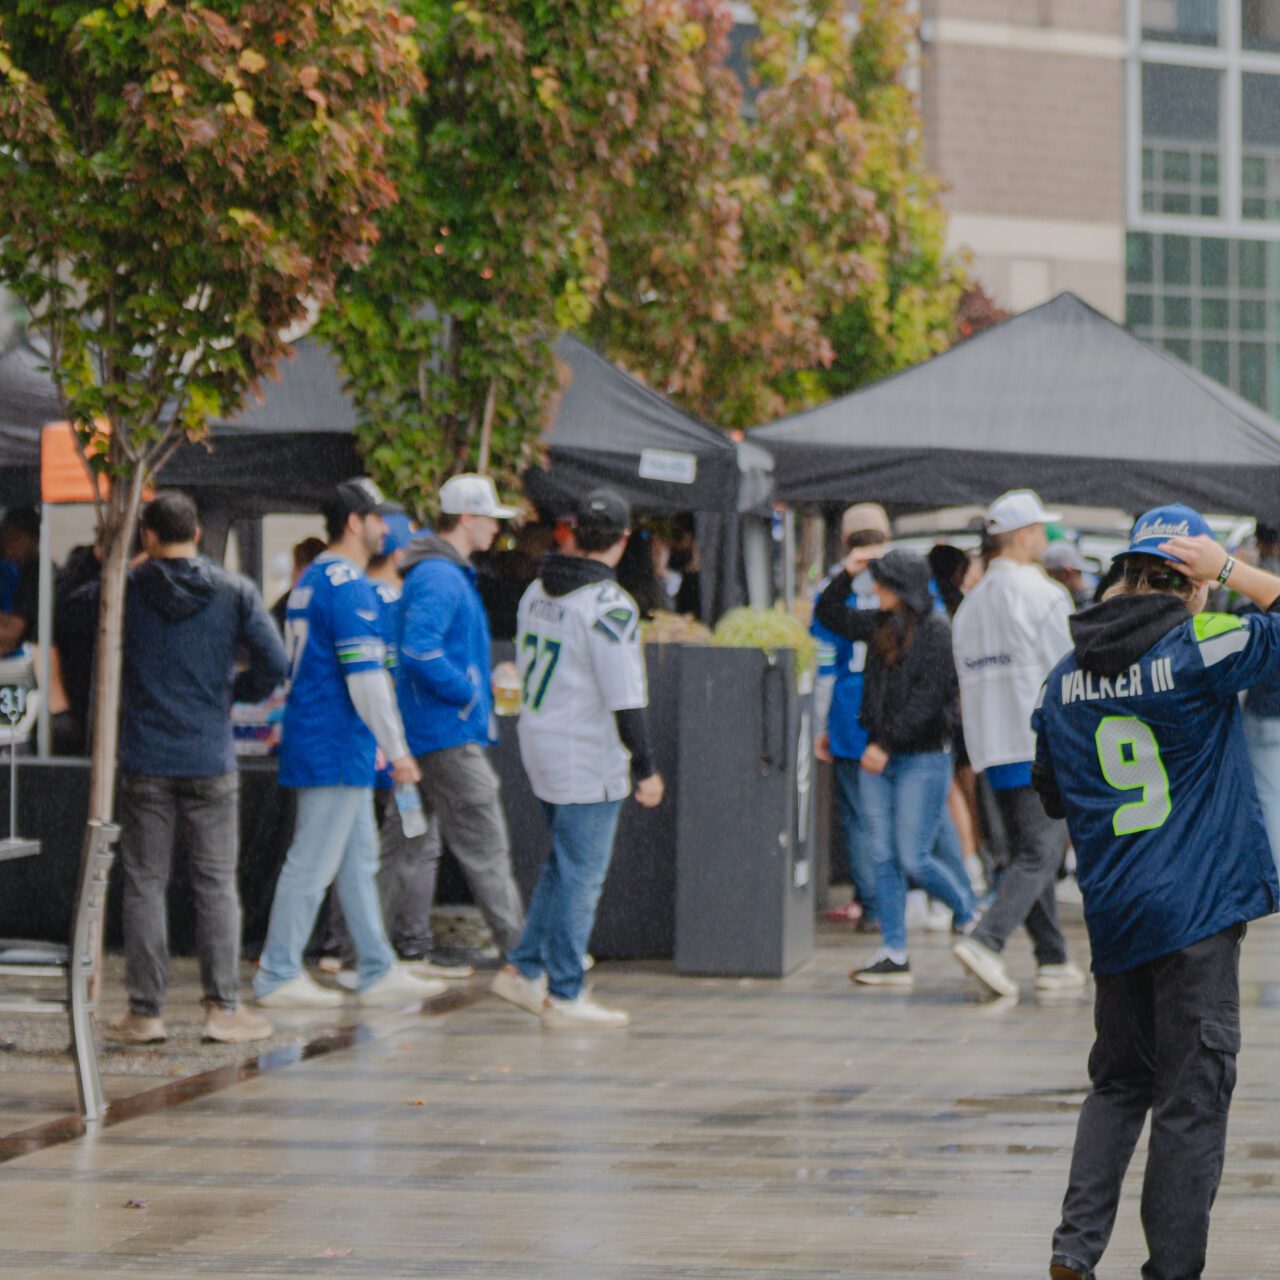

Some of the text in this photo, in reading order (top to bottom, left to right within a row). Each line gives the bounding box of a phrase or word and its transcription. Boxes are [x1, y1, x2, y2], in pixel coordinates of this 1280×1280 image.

[0, 686, 25, 714] 31
[1061, 657, 1175, 705] WALKER III
[1095, 715, 1172, 837] 9
